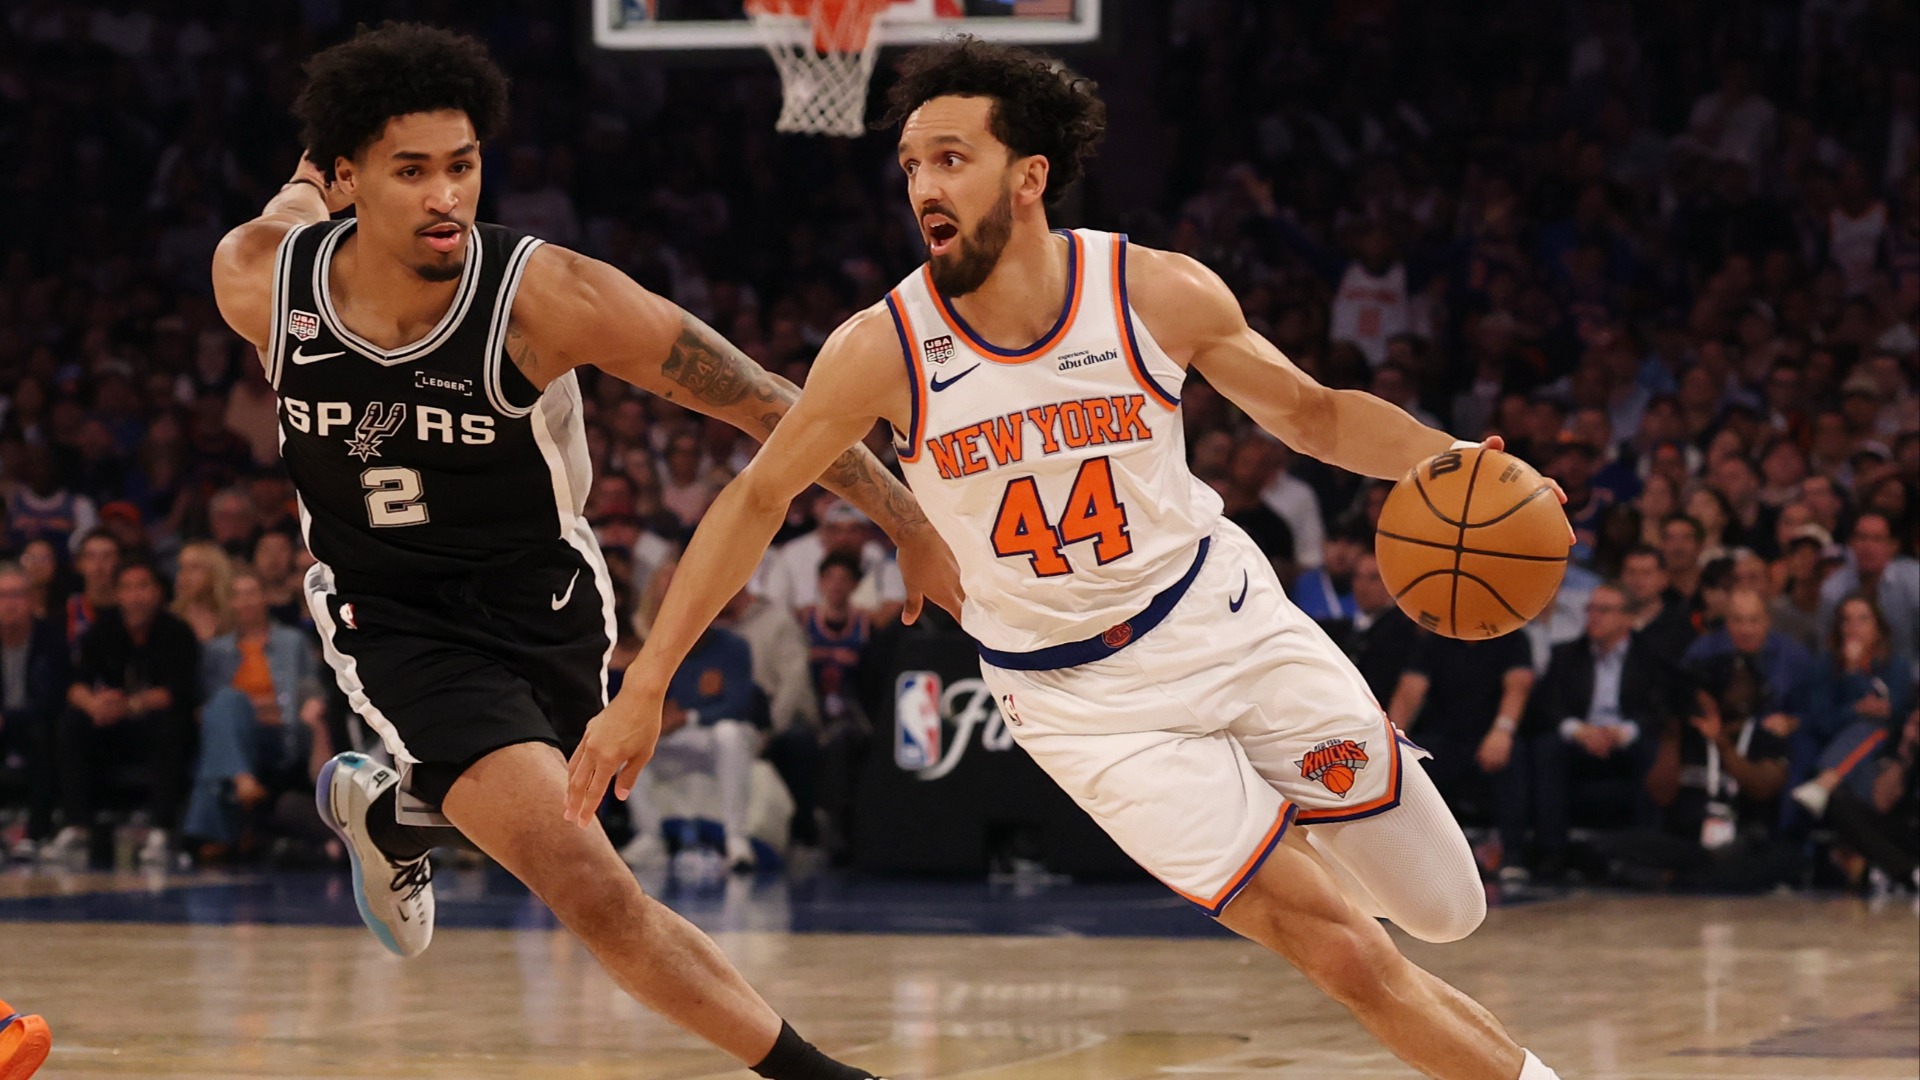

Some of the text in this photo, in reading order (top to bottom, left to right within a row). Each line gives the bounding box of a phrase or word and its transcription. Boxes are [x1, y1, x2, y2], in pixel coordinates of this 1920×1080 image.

[293, 313, 316, 325] USA
[925, 337, 951, 349] USA
[927, 348, 954, 362] 250
[1058, 359, 1082, 371] abu
[422, 376, 465, 391] LEDGER
[925, 394, 1153, 480] NEW YORK
[360, 466, 430, 528] 2
[990, 455, 1134, 578] 44
[1301, 740, 1369, 779] KNICKS
